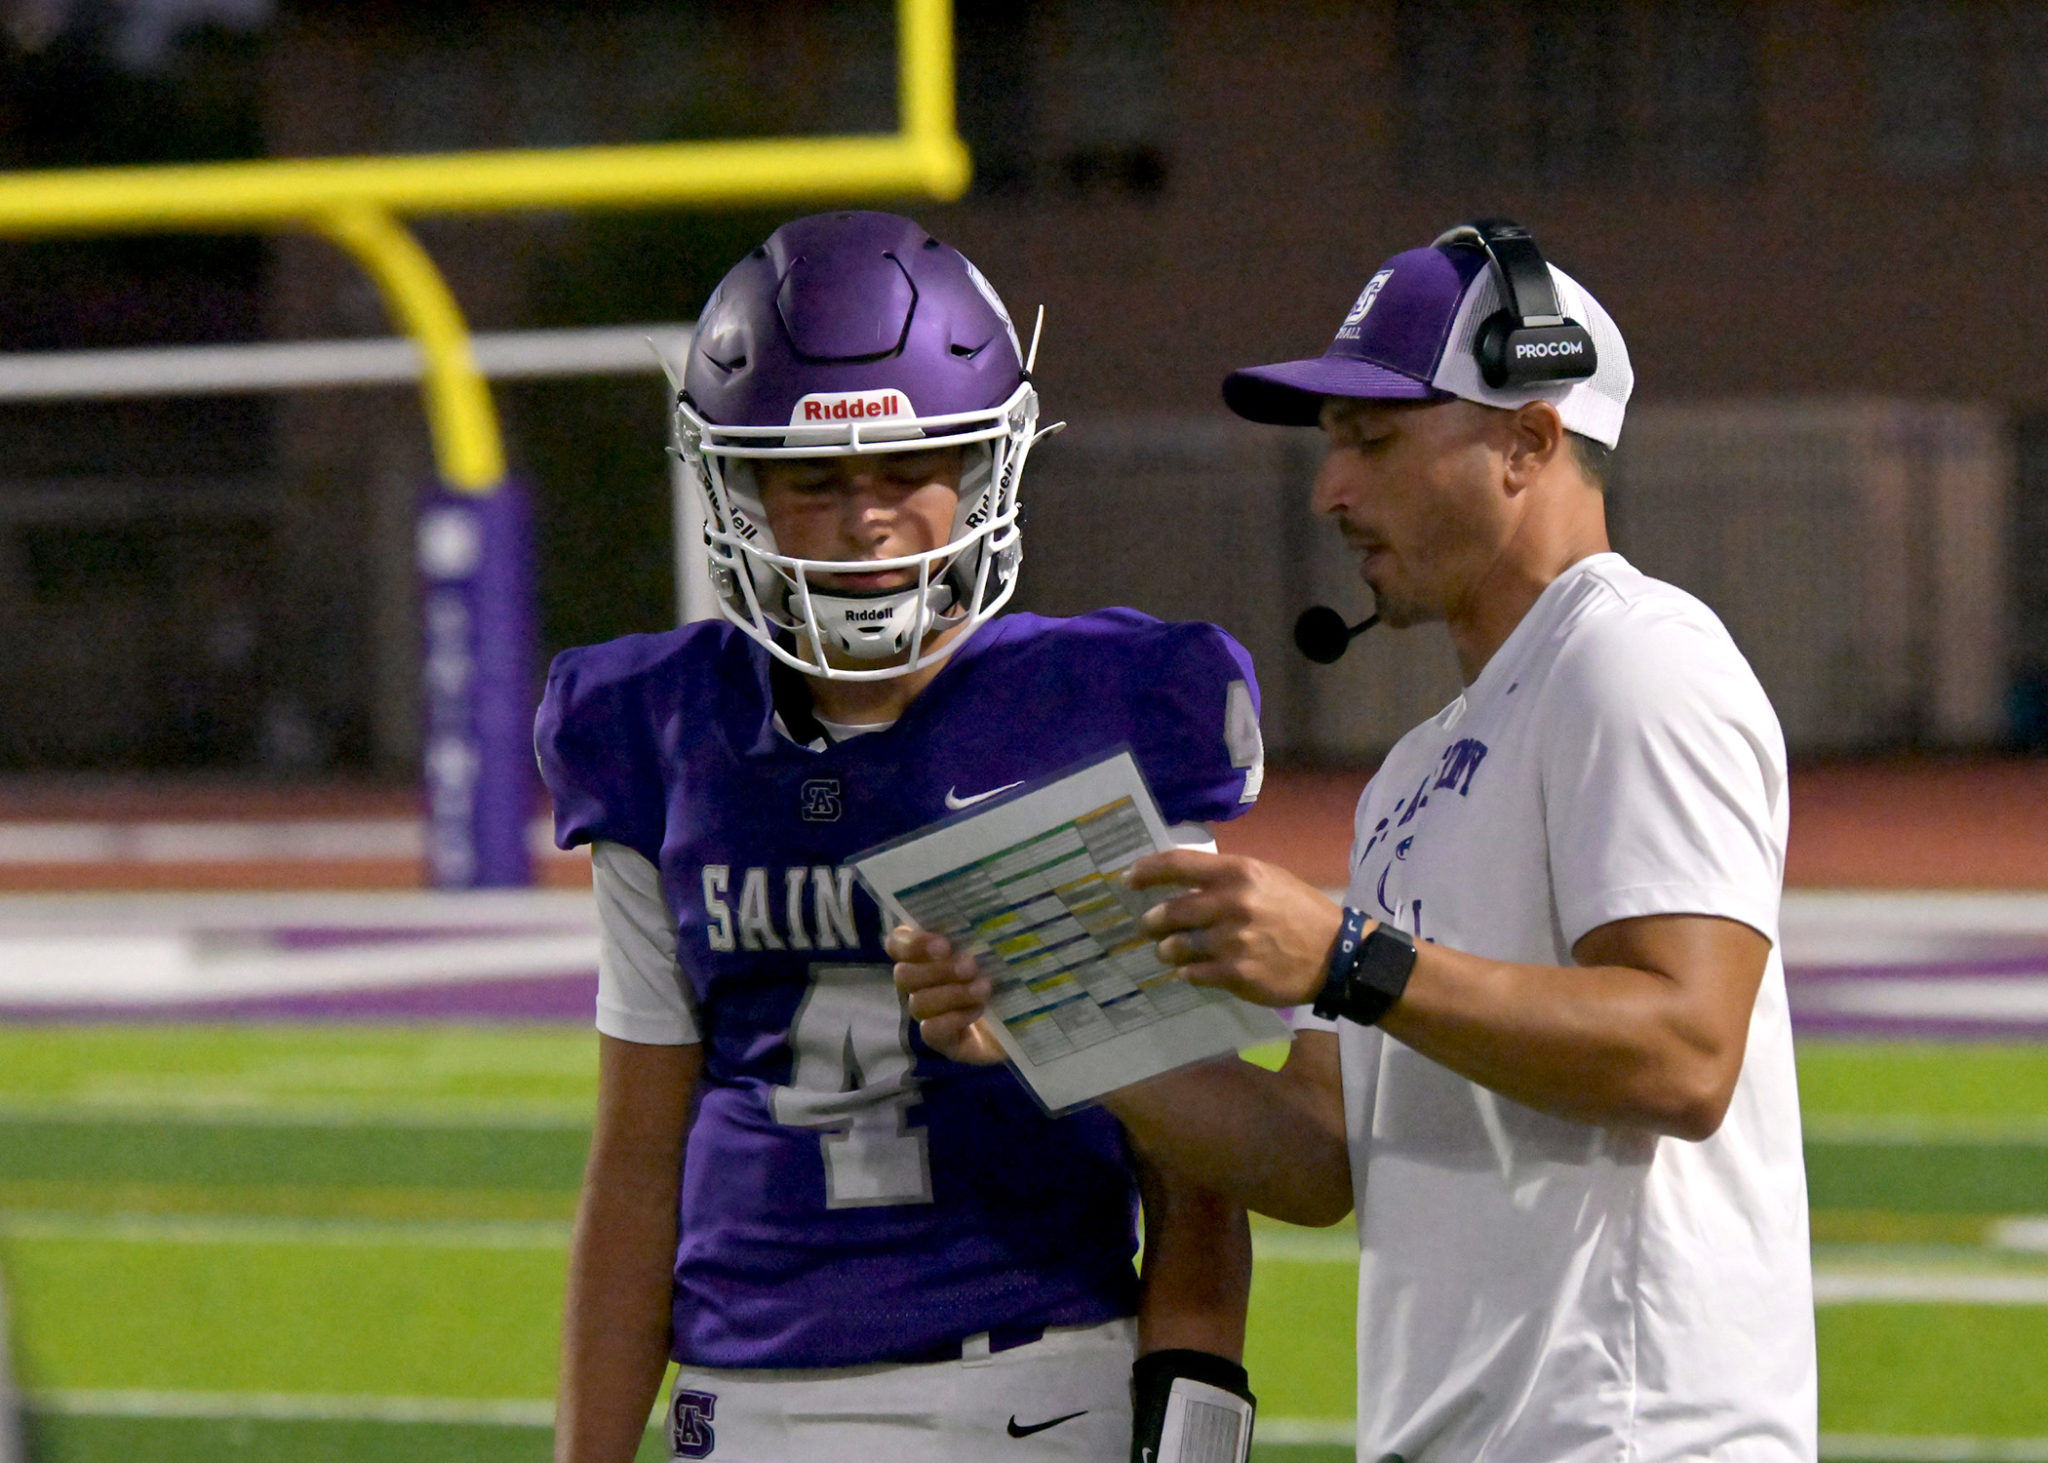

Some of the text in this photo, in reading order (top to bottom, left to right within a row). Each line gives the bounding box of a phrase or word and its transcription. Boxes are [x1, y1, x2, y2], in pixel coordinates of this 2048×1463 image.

[1515, 341, 1583, 359] PROCOM
[804, 395, 898, 421] Riddell
[965, 462, 1013, 529] Ridell
[845, 607, 894, 622] Riddell
[702, 863, 896, 952] SAIN
[768, 962, 934, 1211] 4
